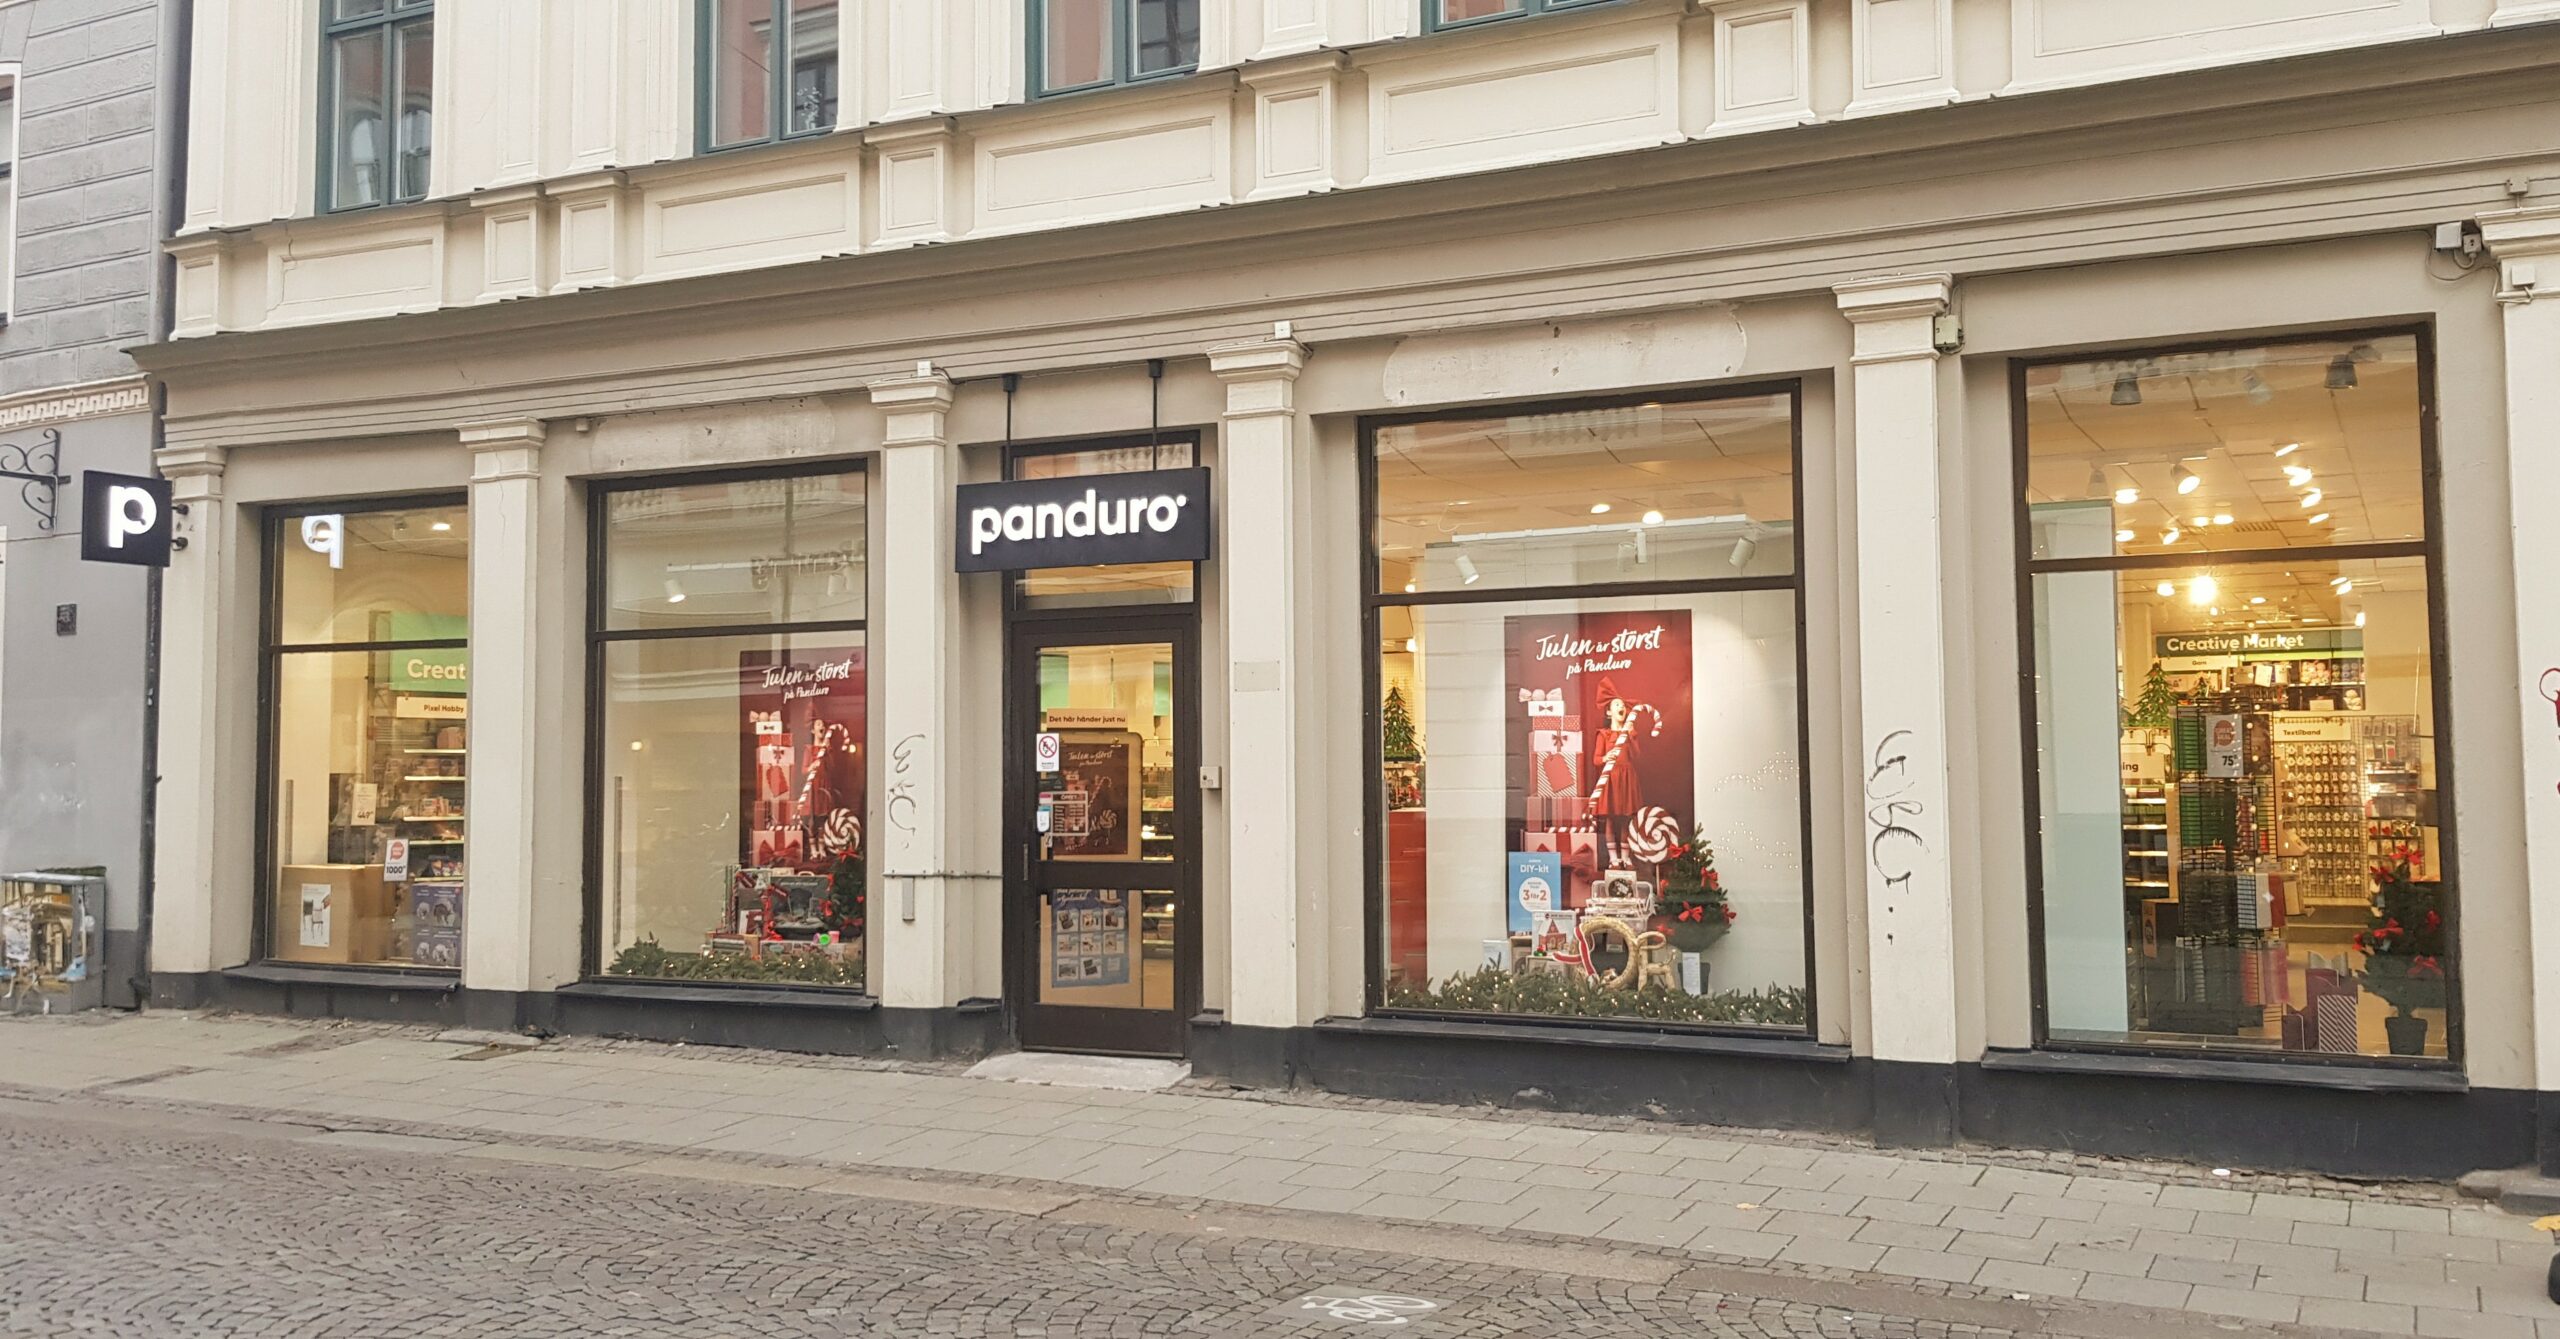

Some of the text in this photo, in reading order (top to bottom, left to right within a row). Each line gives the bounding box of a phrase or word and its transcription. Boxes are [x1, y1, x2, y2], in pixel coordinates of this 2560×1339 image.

[971, 489, 1188, 555] panduro
[1536, 625, 1665, 661] Julen är störst
[2166, 633, 2304, 651] Creative Market
[762, 666, 804, 688] Julen
[815, 659, 853, 683] störst
[1566, 654, 1632, 680] på Panduro
[783, 683, 829, 704] på Panduro
[424, 704, 464, 713] Pixel Hobby
[1063, 715, 1075, 723] här
[1076, 715, 1101, 723] händer
[1102, 715, 1116, 724] just
[1520, 863, 1550, 874] DIY-kit
[1523, 889, 1547, 901] 3 för 2
